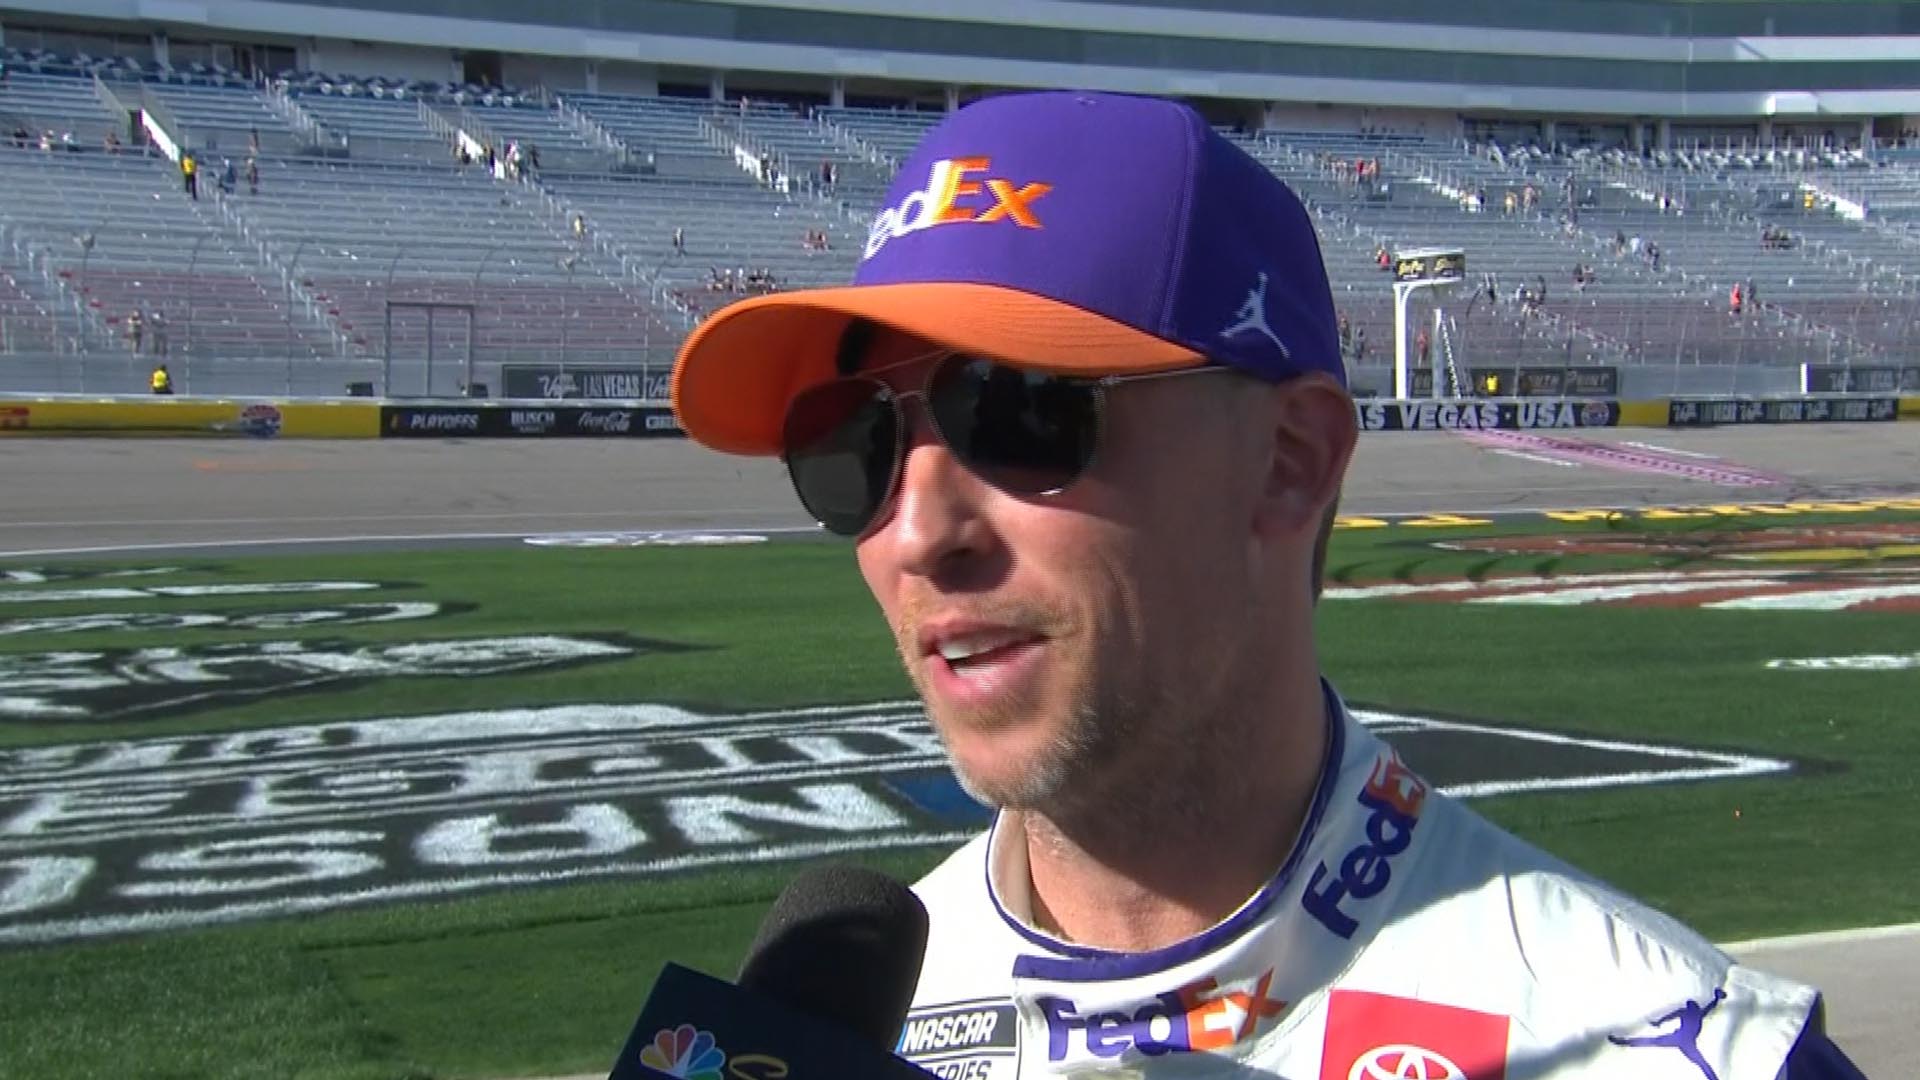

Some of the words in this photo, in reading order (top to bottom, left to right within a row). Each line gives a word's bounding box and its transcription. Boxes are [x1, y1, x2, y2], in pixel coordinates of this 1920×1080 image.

[863, 155, 1053, 261] edEx
[604, 374, 640, 397] VEGAS
[411, 413, 479, 429] PLAYOFFS
[511, 410, 555, 426] BUSCH
[1399, 401, 1499, 429] VEGAS
[1517, 400, 1576, 428] USA
[1301, 750, 1426, 940] FedE
[902, 1011, 998, 1053] NASCAR
[1037, 968, 1288, 1061] FedEx
